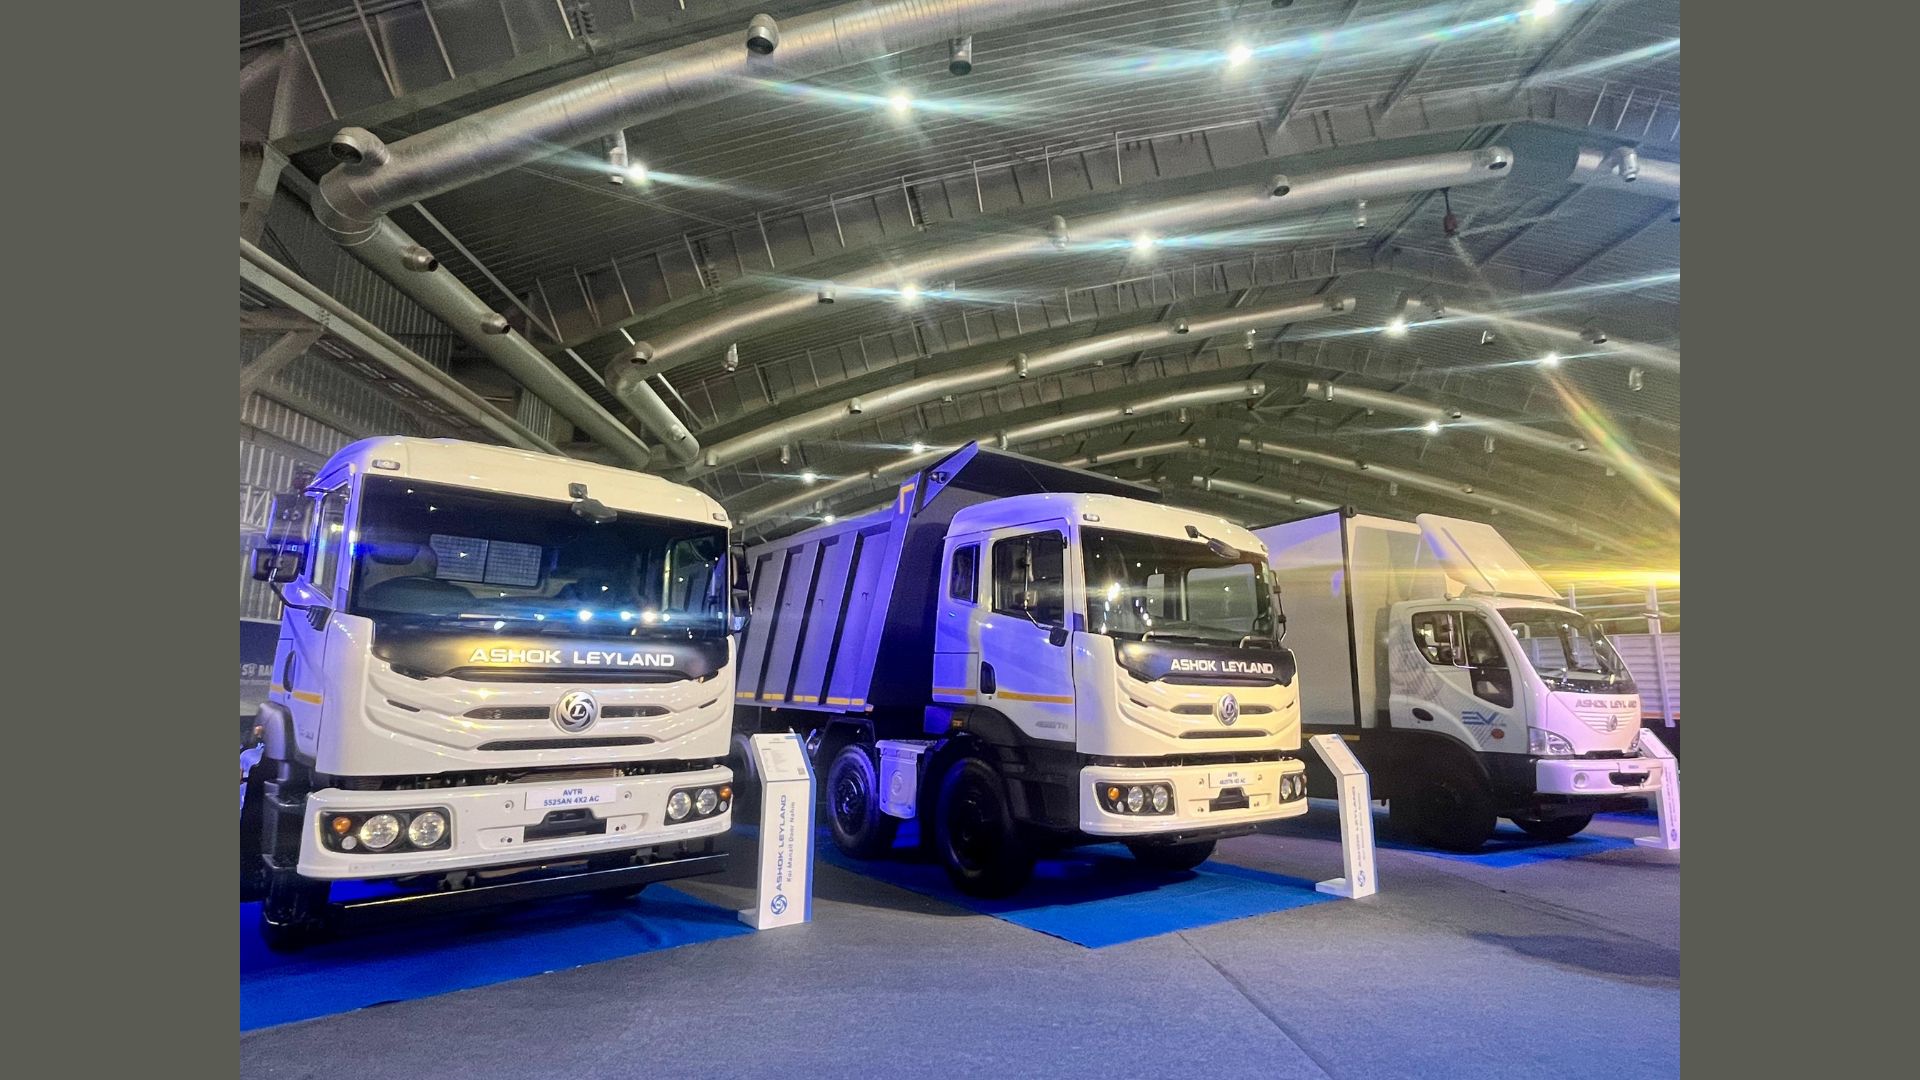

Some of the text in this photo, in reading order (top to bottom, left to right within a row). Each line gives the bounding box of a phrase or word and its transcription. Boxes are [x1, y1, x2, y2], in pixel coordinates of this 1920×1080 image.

[469, 649, 675, 667] ASHOK LEYLAND
[1170, 658, 1274, 674] ASHOK LEYLAND
[574, 704, 586, 718] L
[1461, 711, 1500, 726] EV
[562, 788, 583, 796] AVTR
[543, 795, 600, 807] 5525AN 4X2 AC
[776, 794, 787, 891] ASHOK LEYLAND
